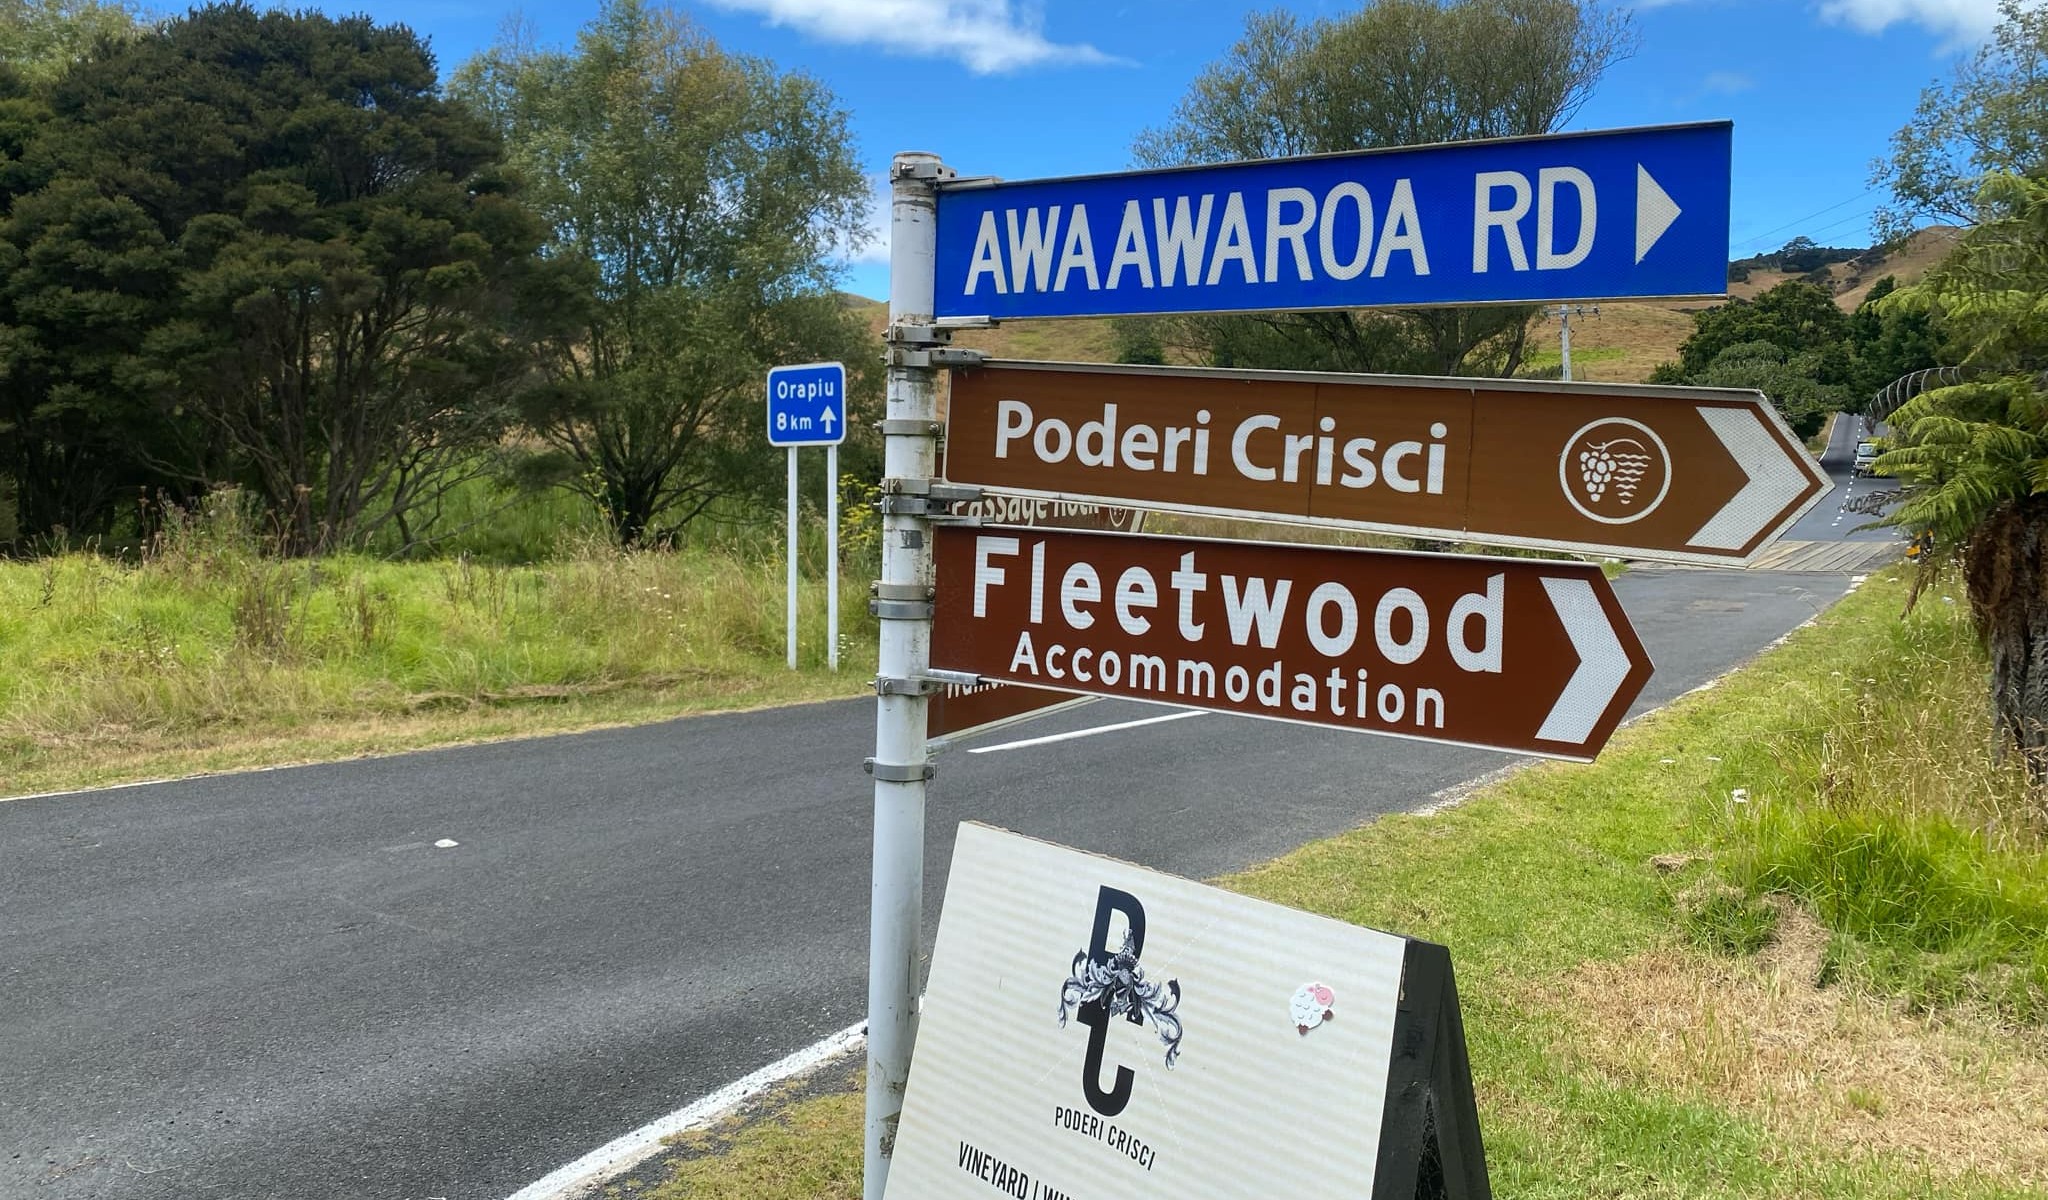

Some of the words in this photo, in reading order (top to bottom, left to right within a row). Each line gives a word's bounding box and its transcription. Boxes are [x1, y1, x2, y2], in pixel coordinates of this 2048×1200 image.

[964, 178, 1431, 295] AWAAWAROA
[1472, 166, 1597, 273] RD
[776, 412, 787, 431] 8
[790, 414, 812, 430] km
[777, 378, 834, 402] Orapiu
[995, 400, 1211, 475] Poderi
[1231, 414, 1448, 495] Crisci
[973, 535, 1505, 674] Fleetwood
[1009, 630, 1445, 729] Accommodation
[958, 1141, 1029, 1200] VINEYARD
[1055, 1106, 1104, 1141] PODERI
[1107, 1125, 1156, 1171] CRISCI
